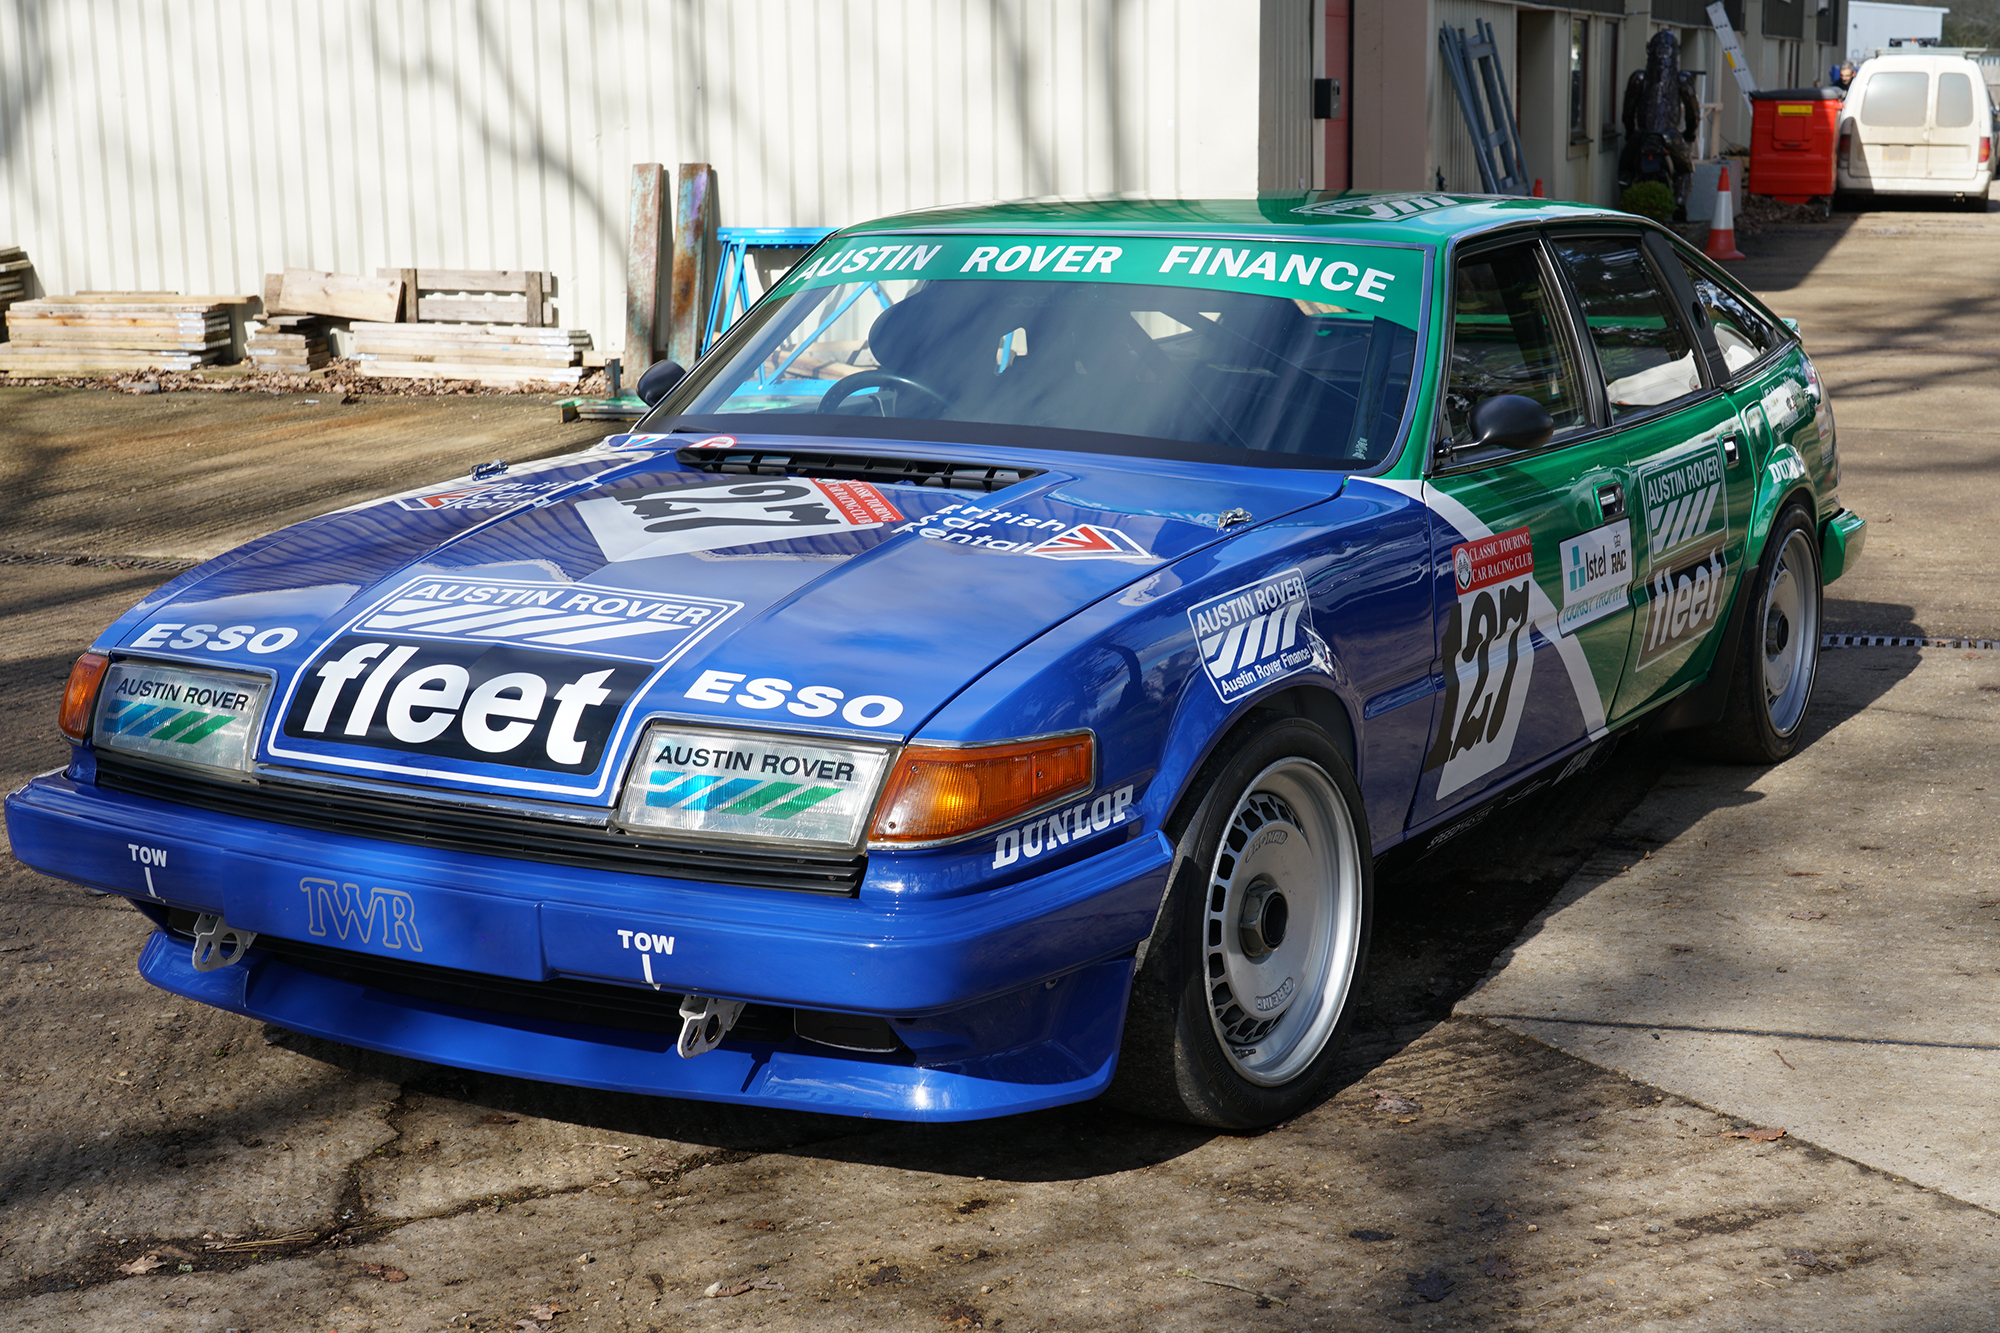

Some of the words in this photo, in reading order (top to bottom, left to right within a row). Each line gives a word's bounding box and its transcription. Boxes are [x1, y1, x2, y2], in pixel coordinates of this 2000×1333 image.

[789, 245, 943, 285] AUSTIN
[959, 245, 1123, 273] ROVER
[1158, 246, 1396, 303] FINANCE
[1648, 471, 1687, 508] AUSTIN
[1688, 454, 1721, 491] ROVER
[608, 475, 842, 533] 127
[850, 509, 873, 524] CLUB
[864, 499, 897, 522] TOURING
[920, 514, 991, 531] Car
[891, 521, 1034, 553] Rental
[1469, 542, 1500, 562] CLASSIC
[1499, 532, 1530, 553] TOURING
[1472, 567, 1488, 583] CAR
[1487, 557, 1515, 578] RACING
[1514, 552, 1533, 569] CLUB
[1585, 545, 1607, 582] Istel
[1611, 549, 1626, 575] RAC
[404, 584, 564, 606] AUSTIN
[560, 590, 712, 625] ROVER
[1196, 600, 1259, 638] AUSTIN
[1257, 576, 1305, 615] ROVER
[1653, 550, 1723, 653] fleet
[130, 623, 299, 655] ESSO
[1221, 670, 1256, 695] Austin
[1255, 658, 1283, 681] Rover
[1280, 647, 1311, 668] Finance
[1424, 580, 1530, 773] 127
[115, 678, 182, 701] AUSTIN
[183, 686, 249, 711] ROVER
[302, 642, 615, 765] fleet
[683, 669, 905, 728] ESSO
[655, 746, 754, 771] AUSTIN
[760, 754, 855, 782] ROVER
[992, 784, 1134, 870] DUNLOP
[127, 843, 167, 868] TOW
[300, 876, 424, 953] TWR
[617, 929, 675, 956] TOW
